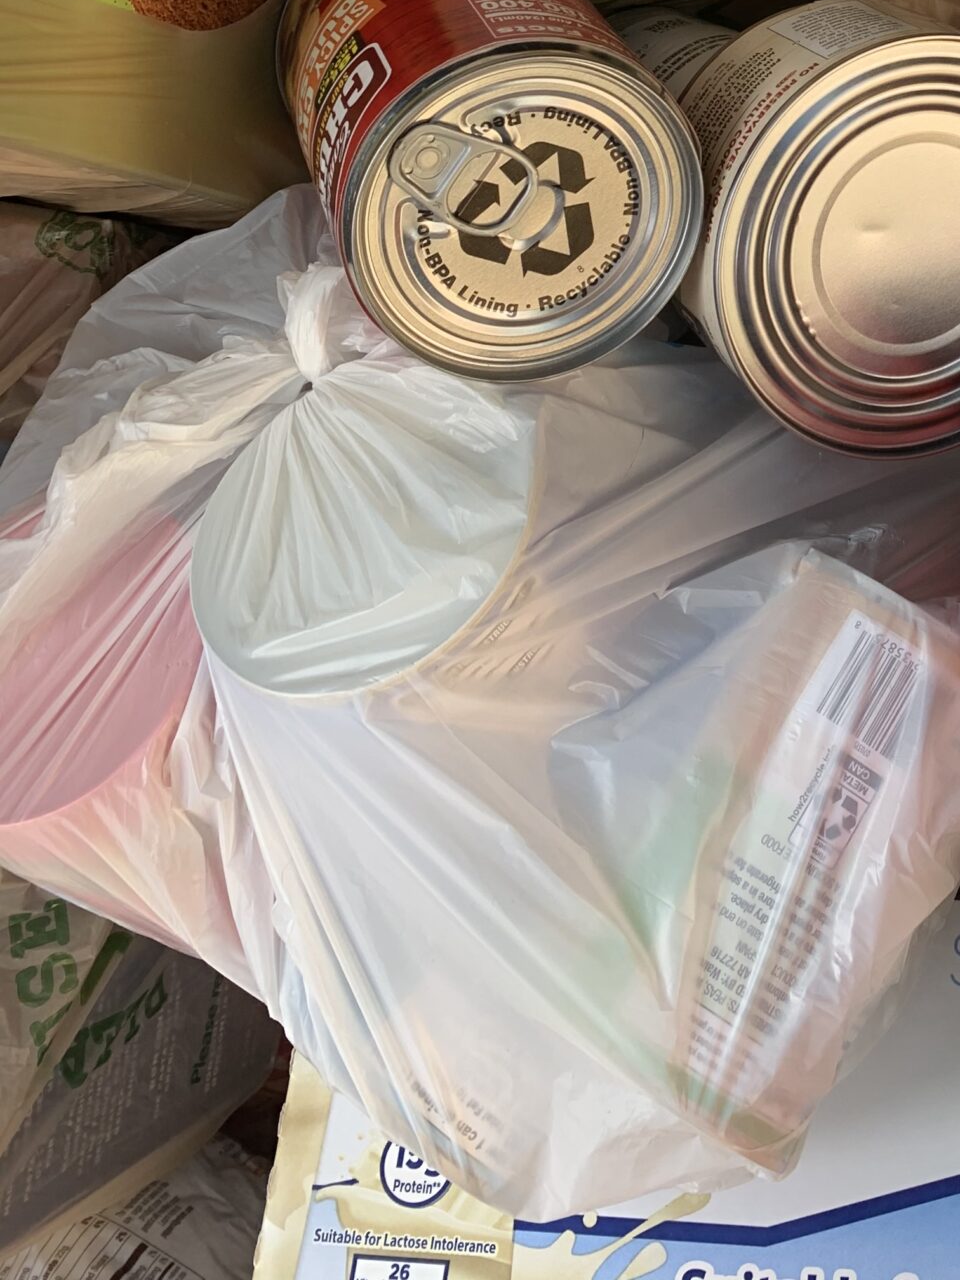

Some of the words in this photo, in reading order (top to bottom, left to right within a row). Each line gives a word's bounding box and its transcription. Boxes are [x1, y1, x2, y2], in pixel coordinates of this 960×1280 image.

[314, 0, 369, 78] SPICY
[544, 108, 607, 144] Lining
[603, 138, 640, 218] Non-BPA
[416, 208, 458, 290] Non-BPA
[538, 232, 630, 312] Recyclable
[456, 284, 520, 319] Lining
[313, 1228, 361, 1246] Suitable
[363, 1230, 382, 1246] for
[383, 1233, 429, 1251] Lactose
[430, 1237, 497, 1256] Intolerance
[388, 1262, 411, 1280] 26
